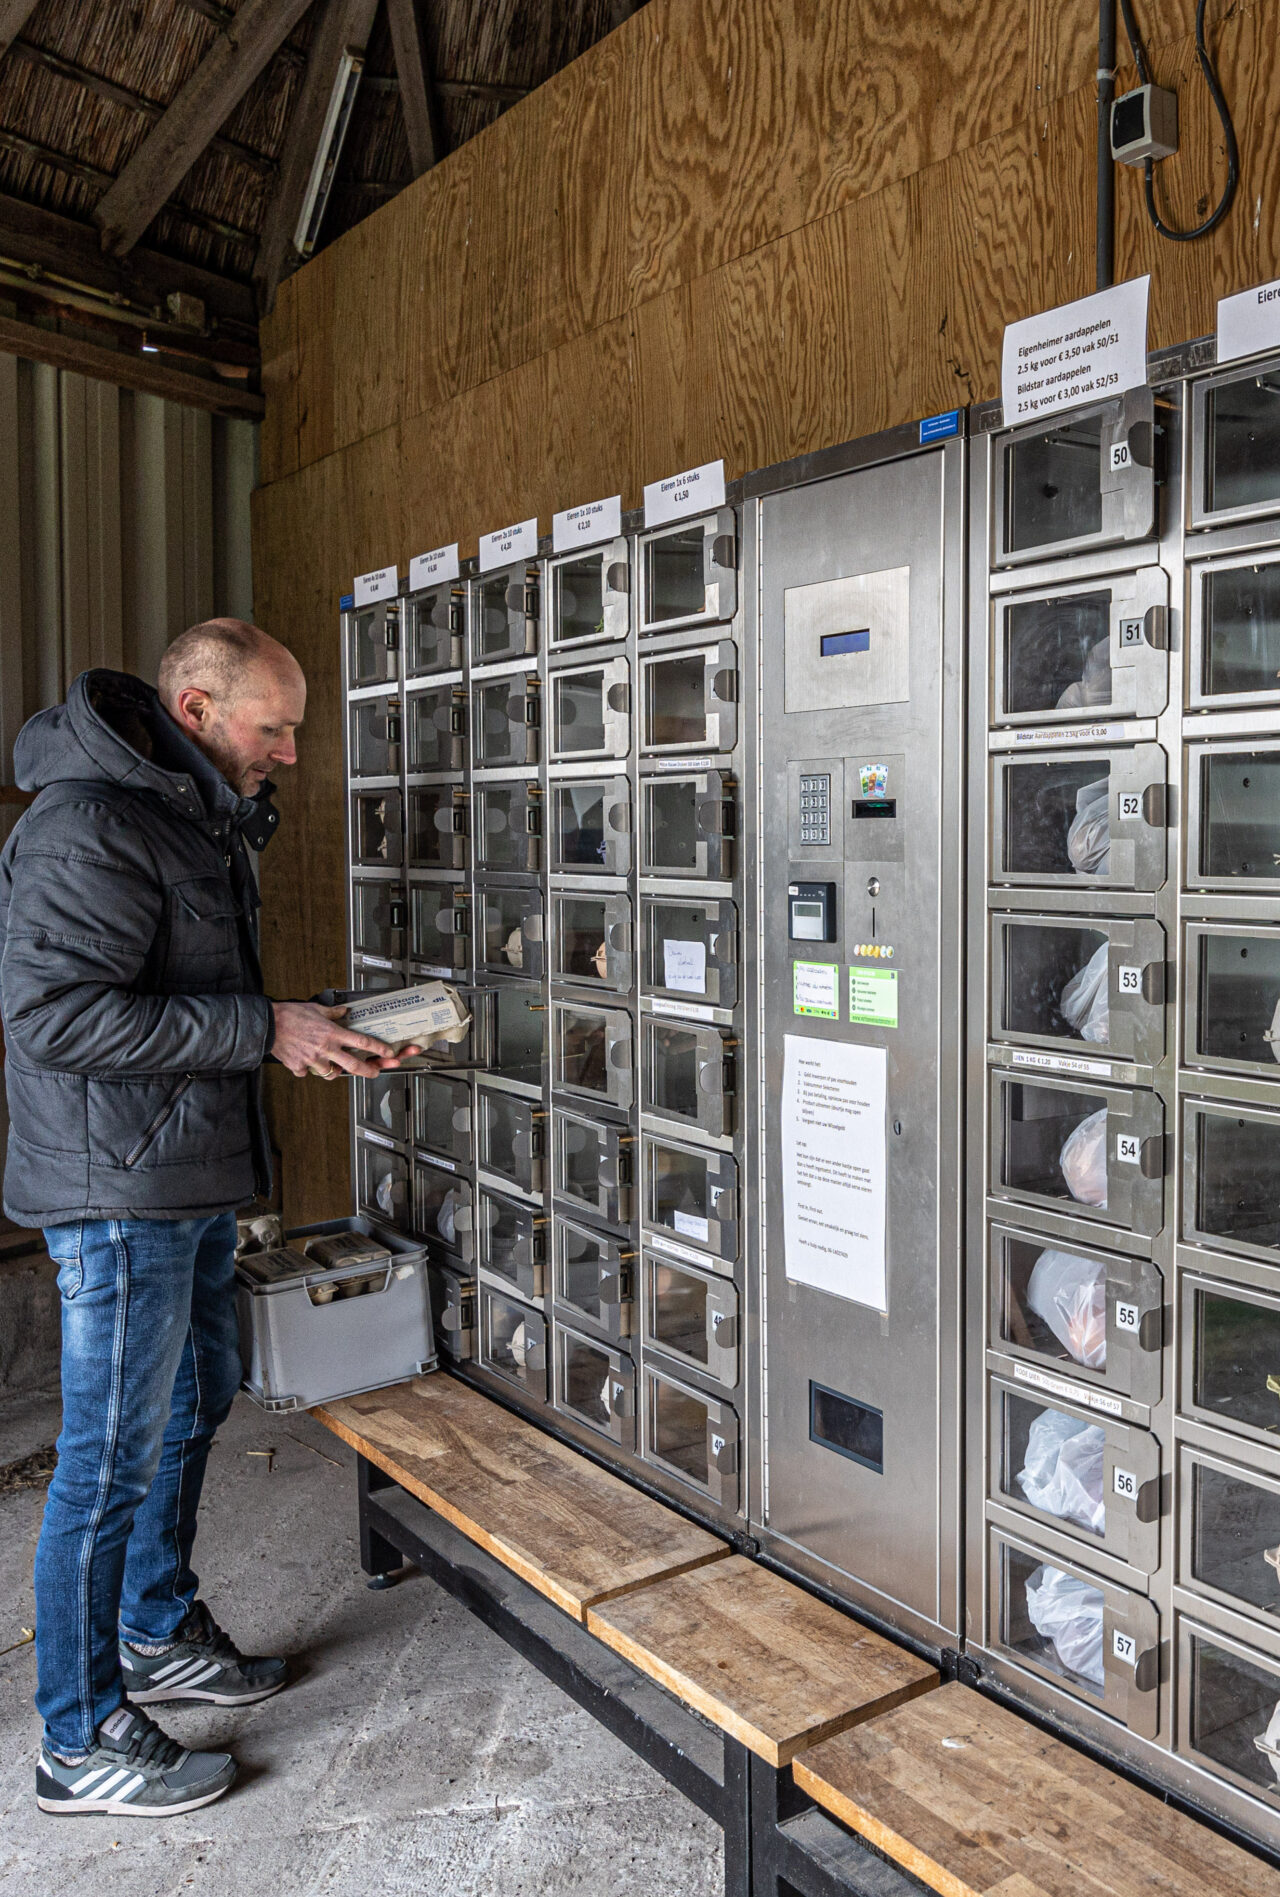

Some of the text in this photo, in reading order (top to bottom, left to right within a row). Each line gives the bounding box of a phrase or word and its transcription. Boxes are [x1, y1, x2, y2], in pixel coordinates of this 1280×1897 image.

[1018, 319, 1111, 357] Eigenheimer aardappelen
[1017, 333, 1119, 375] 2.5 kg voor € 3,50 vak 50/51
[1017, 364, 1092, 395] Bildstar aardappelen
[1018, 372, 1119, 413] 2.5 kg voor € 3,00 vak 52/53
[1113, 447, 1128, 466] 50
[661, 481, 675, 492] Eieren
[686, 472, 700, 483] stuks
[567, 511, 579, 521] Eieren
[592, 504, 603, 513] stuks
[1126, 623, 1140, 641] 51
[1124, 797, 1139, 814] 52
[1123, 972, 1138, 989] 53
[1121, 1141, 1136, 1158] 54
[1120, 1308, 1135, 1326] 55
[1118, 1474, 1133, 1494] 56
[1117, 1637, 1132, 1656] 57
[110, 1713, 128, 1734] adidas
